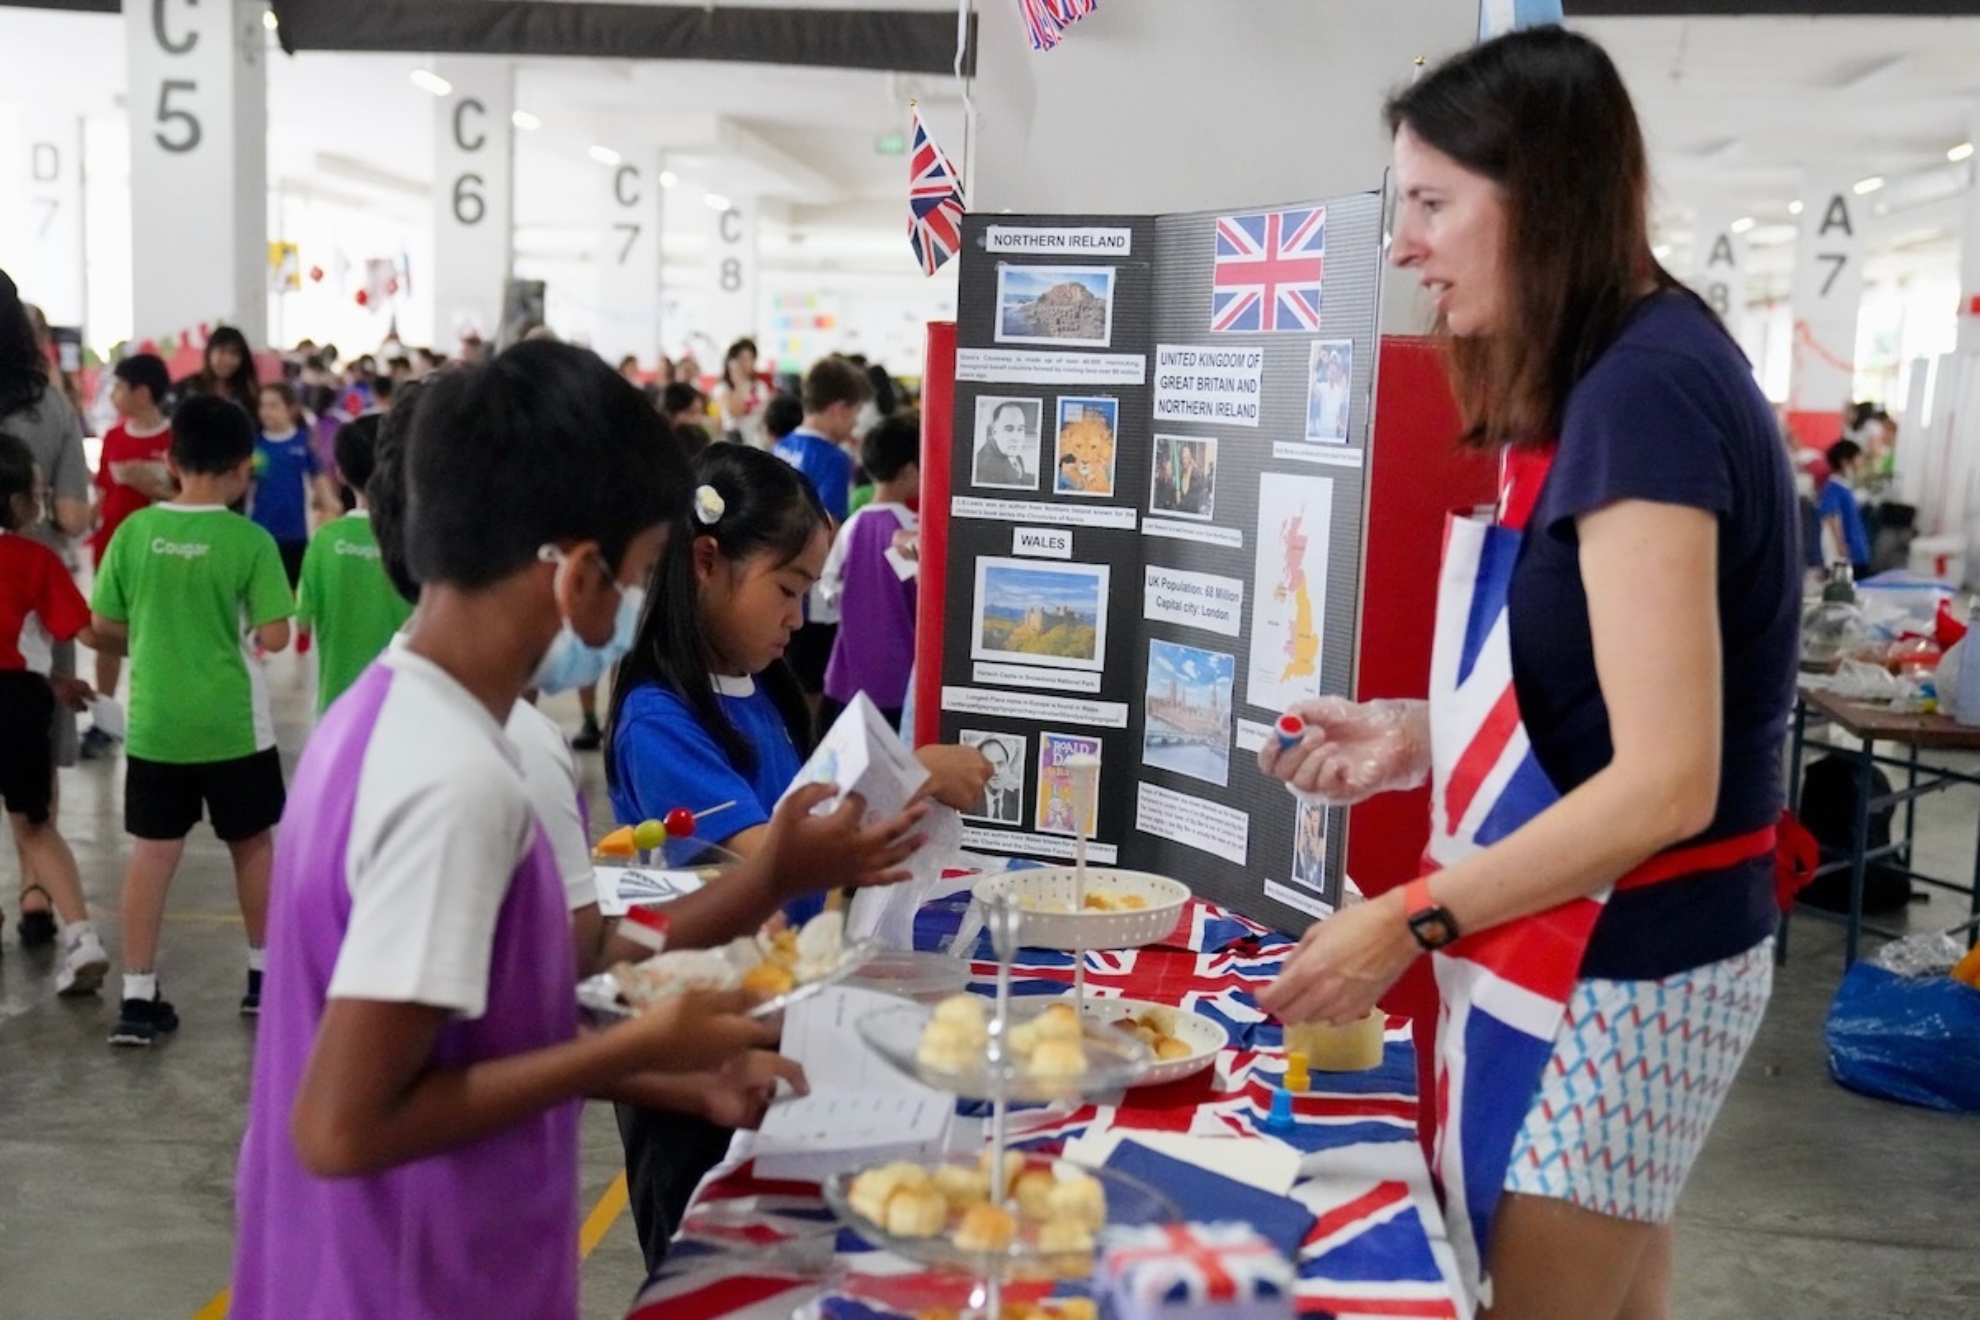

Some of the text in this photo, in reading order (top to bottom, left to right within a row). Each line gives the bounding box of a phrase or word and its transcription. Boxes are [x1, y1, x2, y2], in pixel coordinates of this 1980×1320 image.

[152, 0, 200, 56] C
[155, 78, 202, 154] 5
[453, 98, 486, 152] C
[32, 142, 61, 182] D
[452, 173, 486, 225] 6
[614, 165, 641, 207] C
[31, 197, 61, 239] 7
[719, 210, 741, 244] C
[1817, 195, 1853, 238] A
[613, 224, 641, 265] 7
[994, 234, 1125, 248] NORTHERN IRELAND
[1706, 233, 1735, 267] A
[719, 258, 742, 292] 8
[1816, 255, 1848, 297] 7
[1707, 282, 1730, 315] 8
[1161, 352, 1261, 369] UNITED KINGDOM OF
[1160, 376, 1257, 393] GREAT BRITAIN AND
[1158, 399, 1257, 418] NORTHERN IRELAND
[151, 537, 210, 560] Cougar
[1021, 534, 1065, 550] WALES
[1148, 575, 1160, 588] UK
[1161, 577, 1203, 596] Population:
[1215, 587, 1240, 603] Million
[1156, 595, 1230, 621] Capital city: London
[1053, 740, 1090, 755] ROALD
